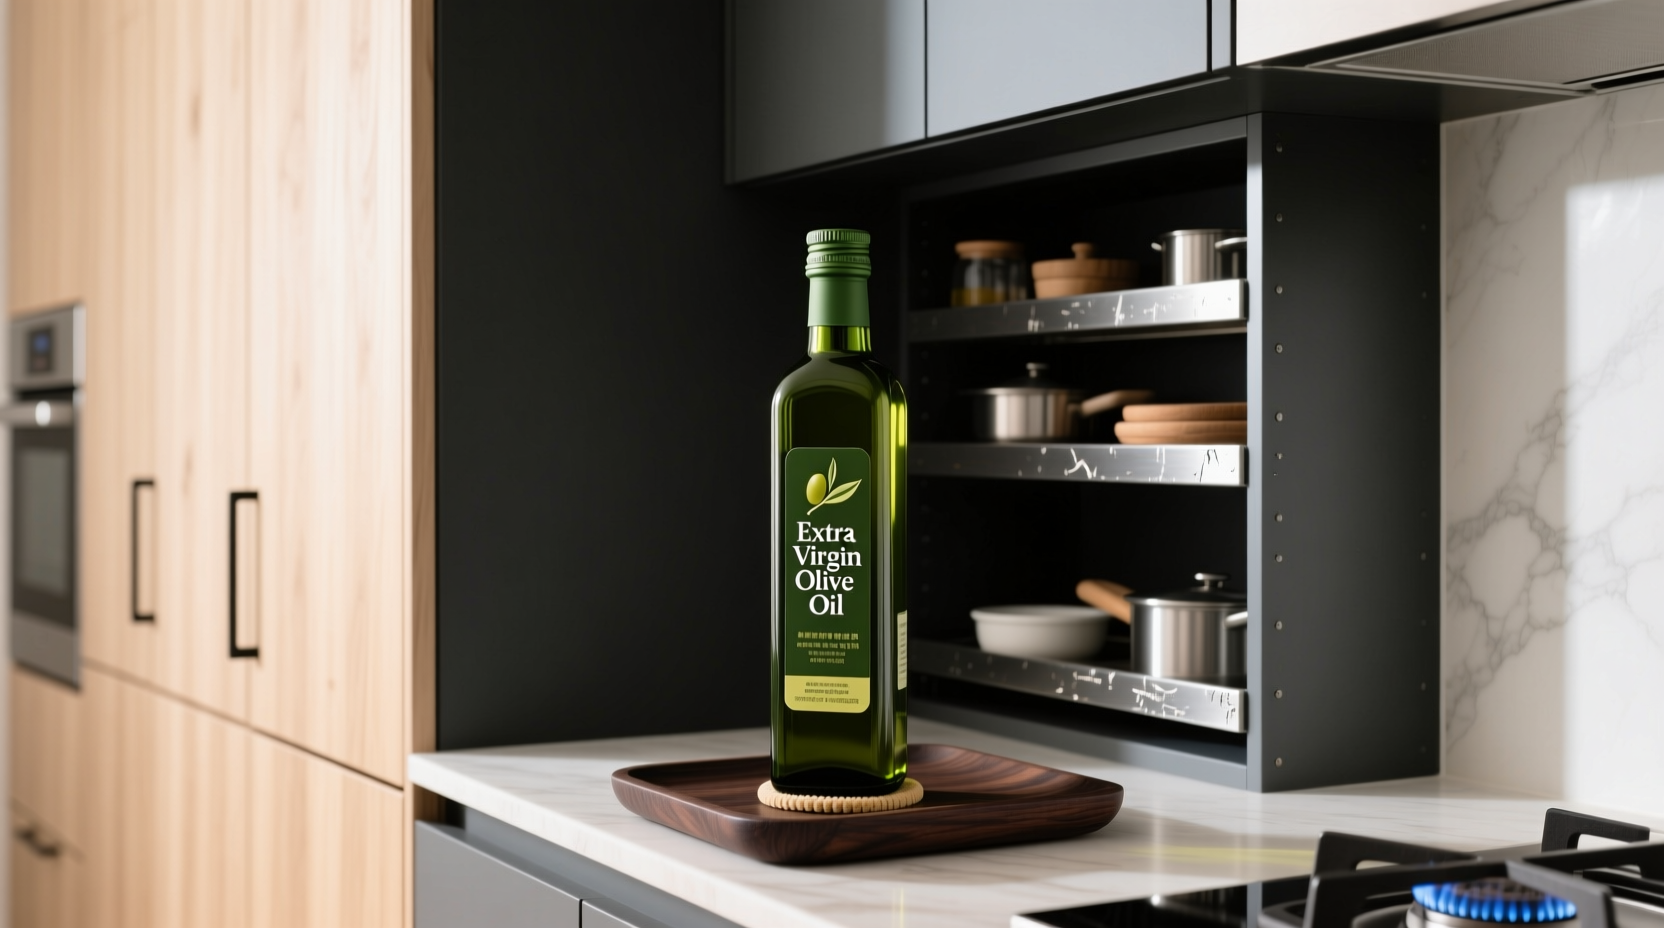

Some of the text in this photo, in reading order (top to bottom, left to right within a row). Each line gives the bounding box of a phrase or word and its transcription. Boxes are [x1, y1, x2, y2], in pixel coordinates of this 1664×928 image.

[796, 521, 857, 543] Extra
[792, 545, 862, 572] Virgin
[795, 569, 854, 591] Olive
[808, 593, 844, 616] Oil
